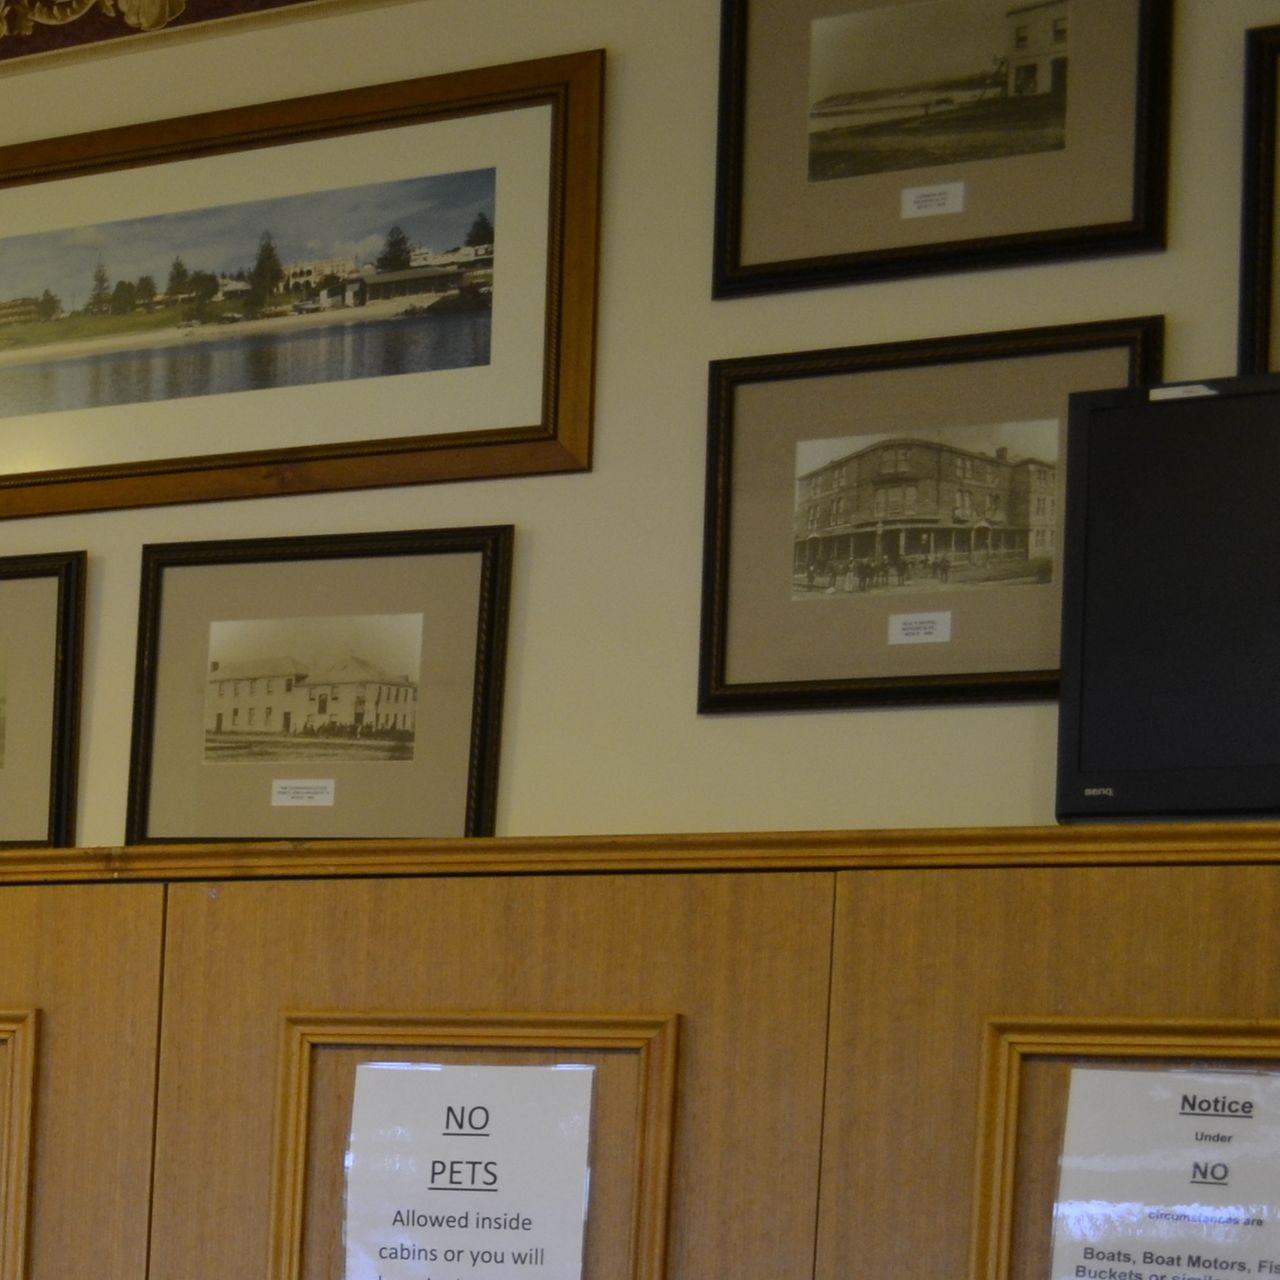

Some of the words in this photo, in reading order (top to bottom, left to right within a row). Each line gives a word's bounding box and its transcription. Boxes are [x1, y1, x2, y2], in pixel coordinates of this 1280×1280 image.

[1180, 1094, 1254, 1115] Notice
[444, 1105, 490, 1131] NO
[1195, 1132, 1232, 1143] Under
[429, 1160, 499, 1186] PETS
[1192, 1162, 1229, 1181] NO
[392, 1209, 469, 1230] Allowed
[476, 1212, 533, 1231] inside
[1148, 1209, 1240, 1225] circumstances
[1243, 1217, 1264, 1227] are
[378, 1243, 438, 1262] cabins
[444, 1247, 464, 1263] or
[470, 1248, 505, 1267] you
[512, 1248, 544, 1266] will
[1083, 1247, 1136, 1265] Boats,
[1142, 1251, 1182, 1267] Boat
[1187, 1255, 1252, 1274] Motors,
